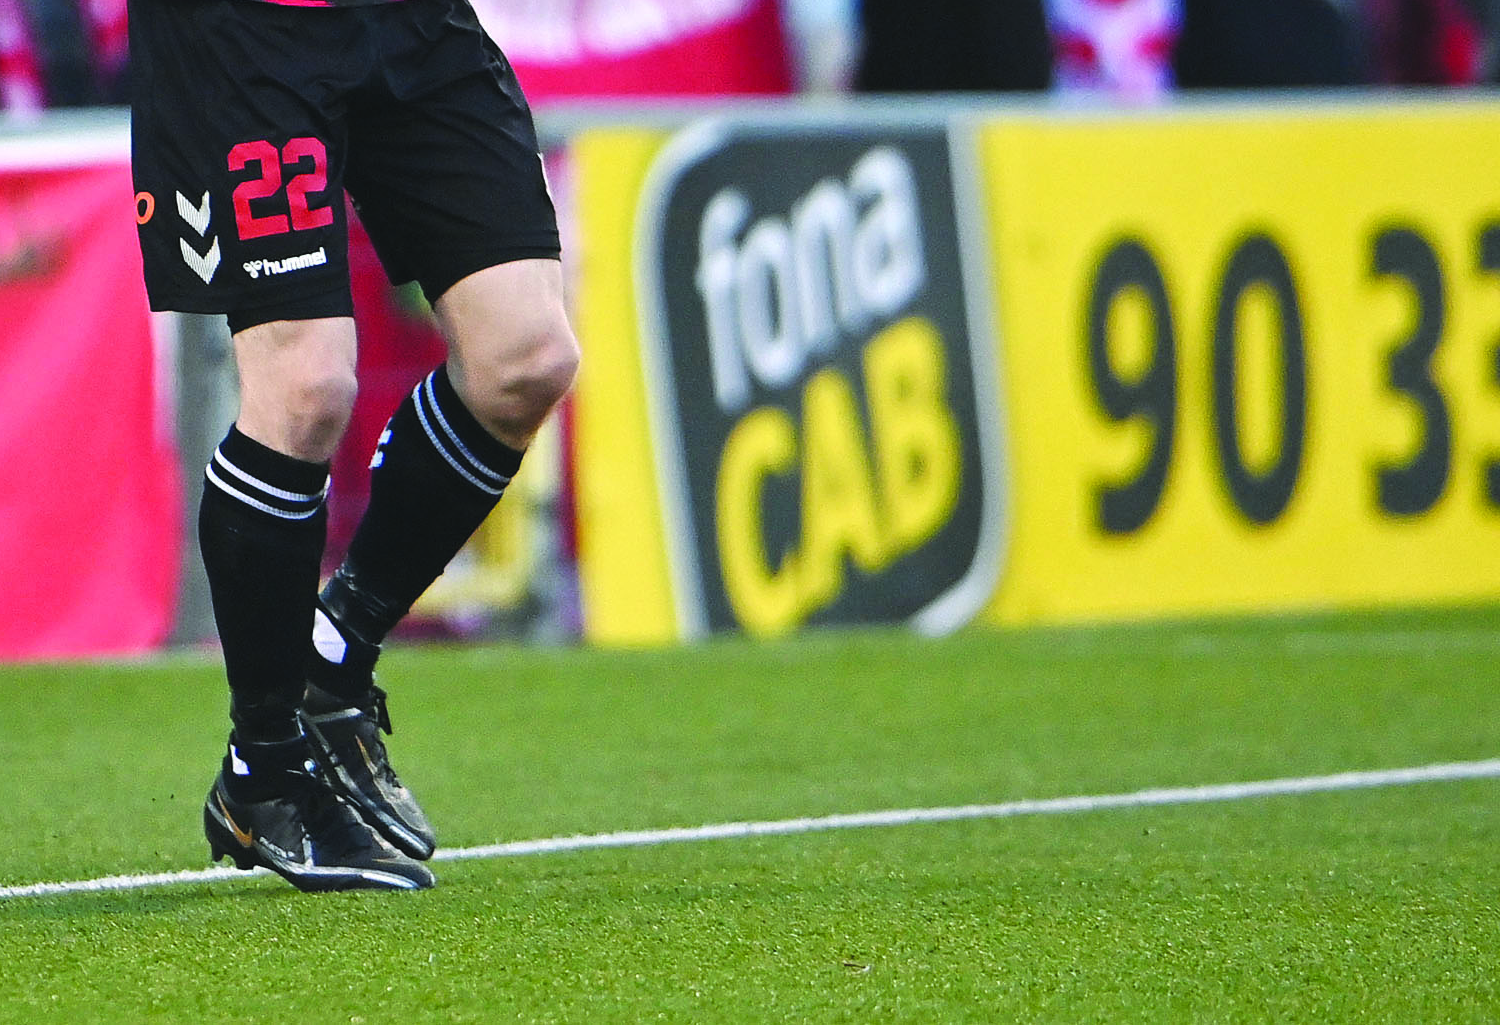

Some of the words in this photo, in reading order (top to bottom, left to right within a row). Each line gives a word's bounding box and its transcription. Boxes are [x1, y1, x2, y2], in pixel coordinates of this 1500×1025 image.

[227, 136, 334, 241] 22
[263, 246, 328, 276] hummel
[694, 144, 925, 412] fona
[714, 314, 964, 639] CAB
[1086, 229, 1308, 538] 90
